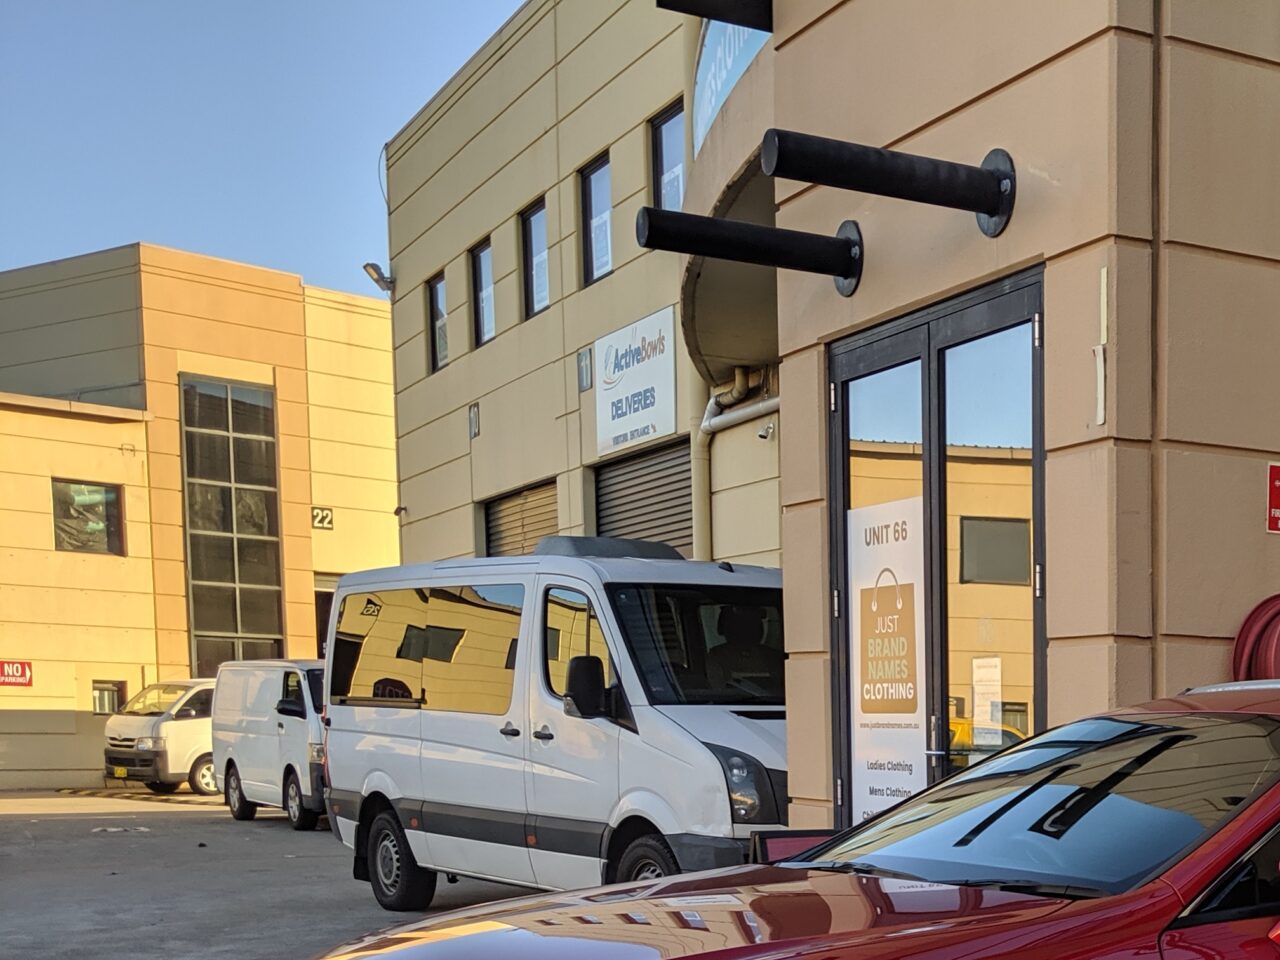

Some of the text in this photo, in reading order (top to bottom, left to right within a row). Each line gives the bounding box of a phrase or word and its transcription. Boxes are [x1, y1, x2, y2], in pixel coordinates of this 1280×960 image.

[611, 386, 656, 421] DELIVERIES
[313, 509, 332, 528] 22
[864, 520, 908, 547] UNIT 66
[875, 615, 899, 633] JUST
[868, 636, 908, 657] BRAND
[4, 663, 22, 676] NO
[868, 658, 908, 680] NAMES
[863, 682, 914, 700] CLOTHING
[867, 761, 913, 775] Ladies Clothing
[869, 786, 884, 797] Mens
